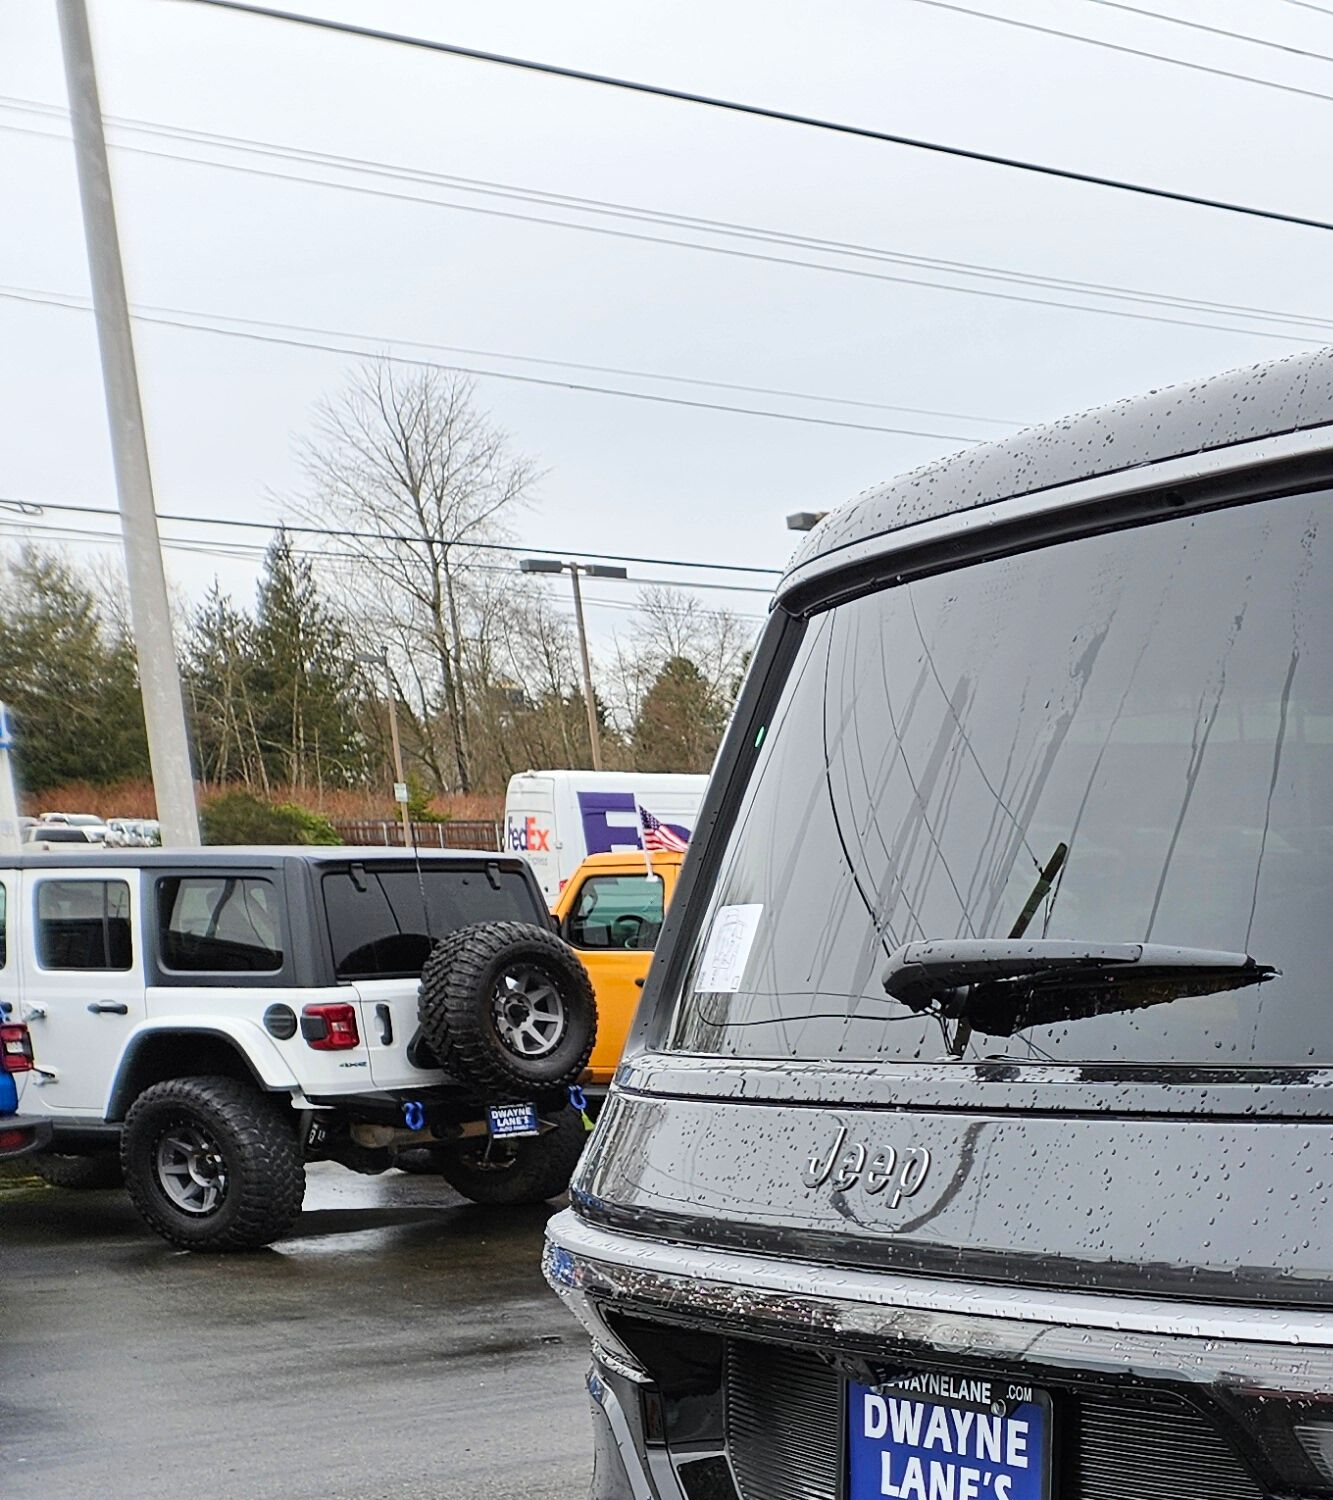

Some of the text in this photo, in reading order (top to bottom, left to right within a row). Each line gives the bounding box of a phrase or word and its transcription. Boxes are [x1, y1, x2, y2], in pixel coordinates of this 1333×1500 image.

[507, 815, 550, 852] FedEx
[802, 1126, 931, 1209] Jeep
[887, 1373, 1032, 1405] WAYNELANE .COM
[864, 1393, 1029, 1469] DWAYNE
